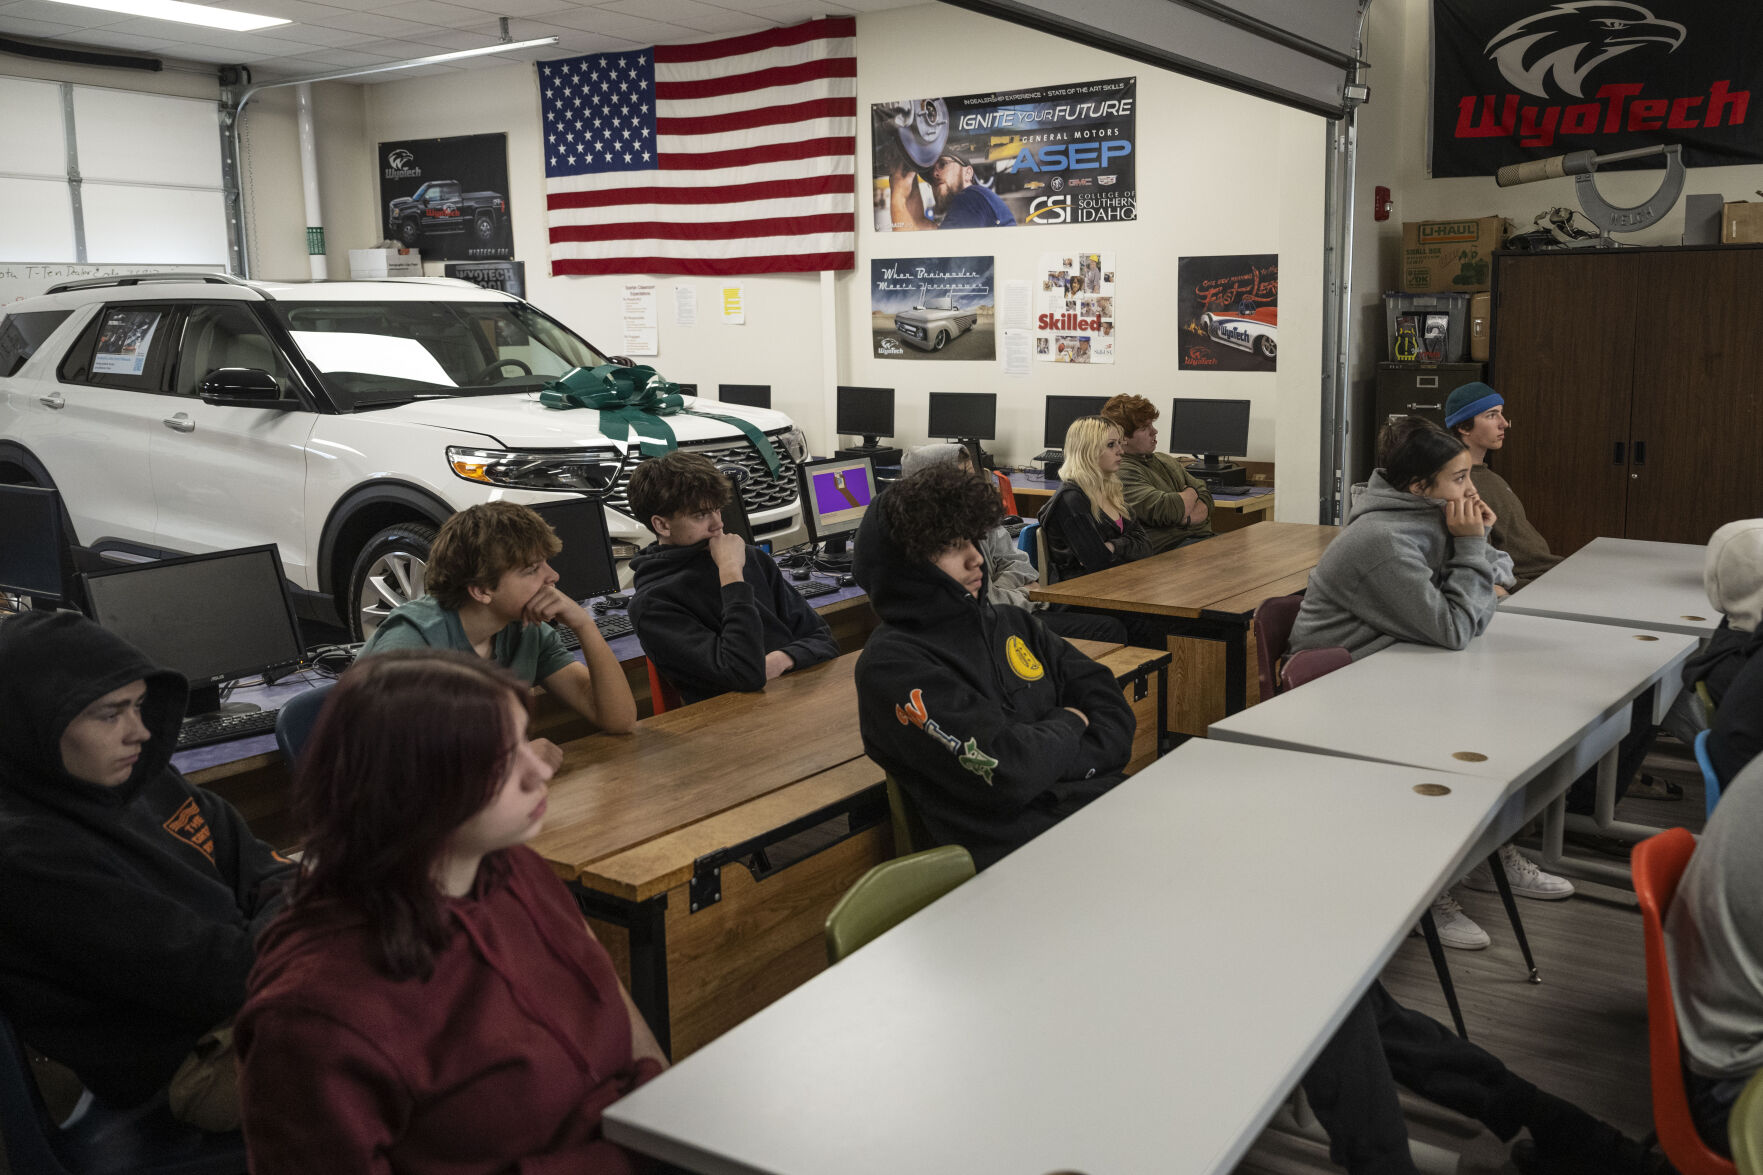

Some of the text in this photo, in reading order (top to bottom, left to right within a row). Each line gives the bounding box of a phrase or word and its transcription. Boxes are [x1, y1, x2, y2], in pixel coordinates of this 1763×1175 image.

[1005, 92, 1042, 102] EXPERIENCE
[1048, 89, 1067, 97] STATE
[1067, 87, 1076, 95] OF
[1076, 86, 1088, 94] THE
[1089, 85, 1102, 93] ART
[1103, 83, 1125, 91] SKILLS
[958, 99, 1133, 131] IGNITE YOUR FUTURE
[1454, 80, 1751, 148] WyoTech
[1022, 128, 1119, 143] GENERAL MOTORS
[1010, 140, 1132, 174] ASEP
[385, 166, 422, 180] WyoTech
[1068, 178, 1092, 187] GMC
[1078, 191, 1119, 200] COLLEGE
[1078, 197, 1136, 209] SOUTHERN
[1029, 194, 1072, 224] CSI
[1078, 206, 1136, 222] IDAHO
[1422, 224, 1475, 237] U-HAUL
[455, 268, 514, 281] WYOTECH
[881, 262, 915, 280] When
[876, 281, 917, 290] Meets
[1038, 312, 1102, 332] Skilled
[1220, 326, 1250, 343] WyoTech
[878, 346, 904, 355] WyoTech
